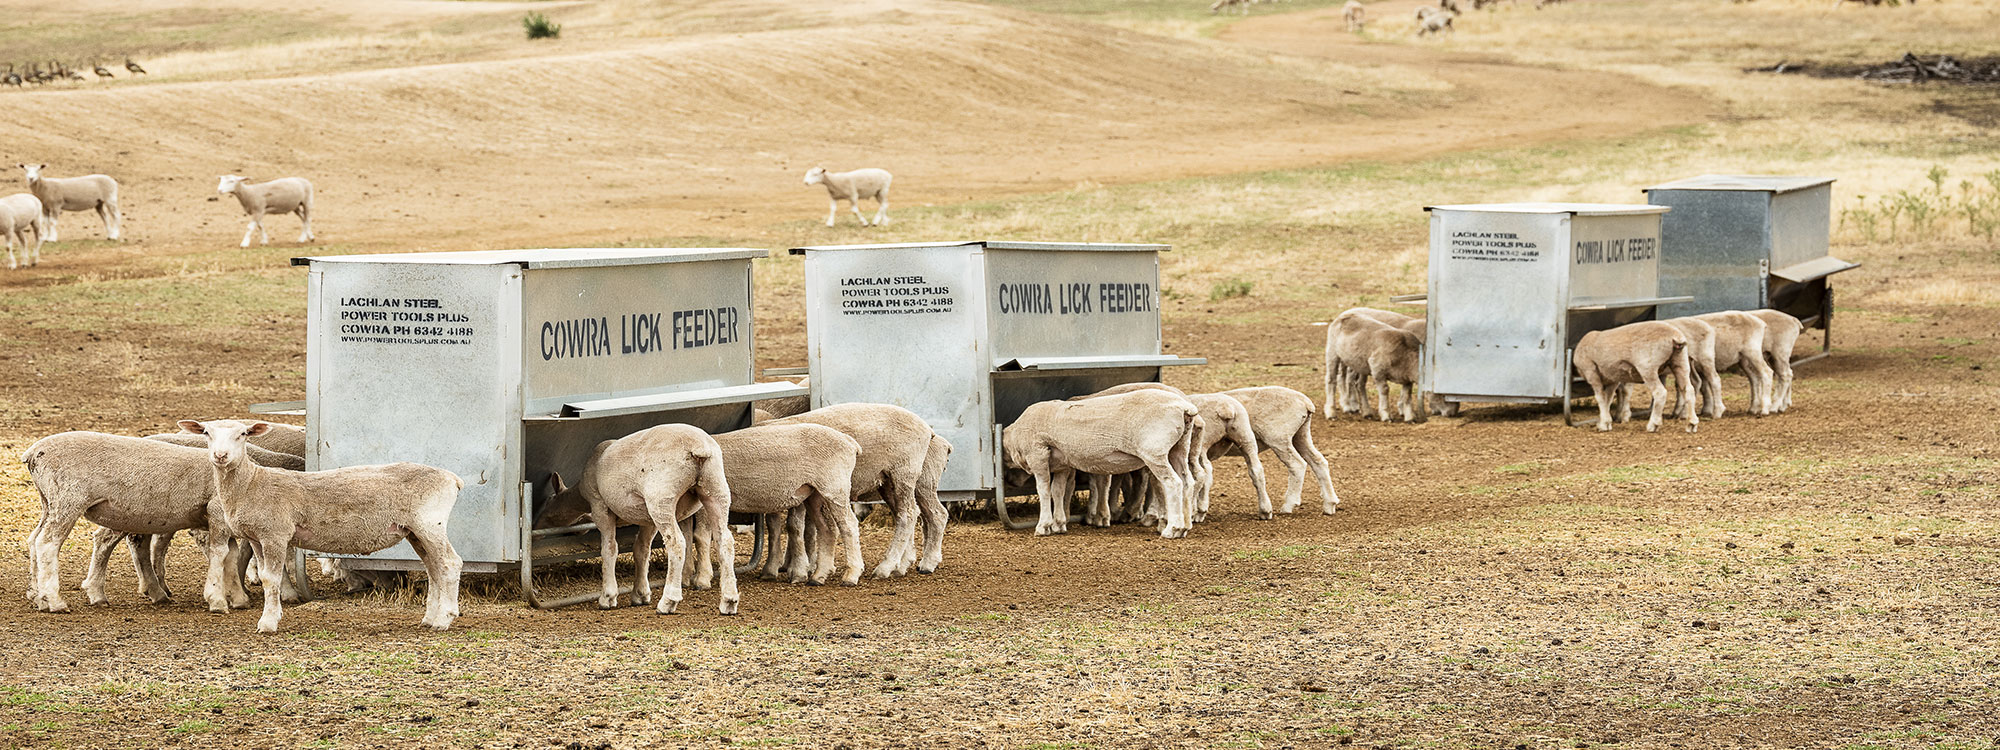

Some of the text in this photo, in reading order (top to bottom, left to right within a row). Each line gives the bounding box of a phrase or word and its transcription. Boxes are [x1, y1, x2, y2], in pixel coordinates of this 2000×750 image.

[1576, 237, 1656, 264] COWRA LICK FEEDER
[841, 276, 926, 286] LACHLAN STEEL
[842, 286, 949, 297] POWER TOOLS PLUS
[341, 297, 443, 309] LACHLAN STEEL
[842, 298, 953, 308] COWRA PH 6342 4188
[999, 282, 1151, 315] COWRA LICK FEEDER
[341, 311, 469, 323] POWER TOOLS PLUS
[341, 324, 474, 336] COWRA PH 6342 4188
[540, 306, 738, 361] COWRA LICK FEEDER
